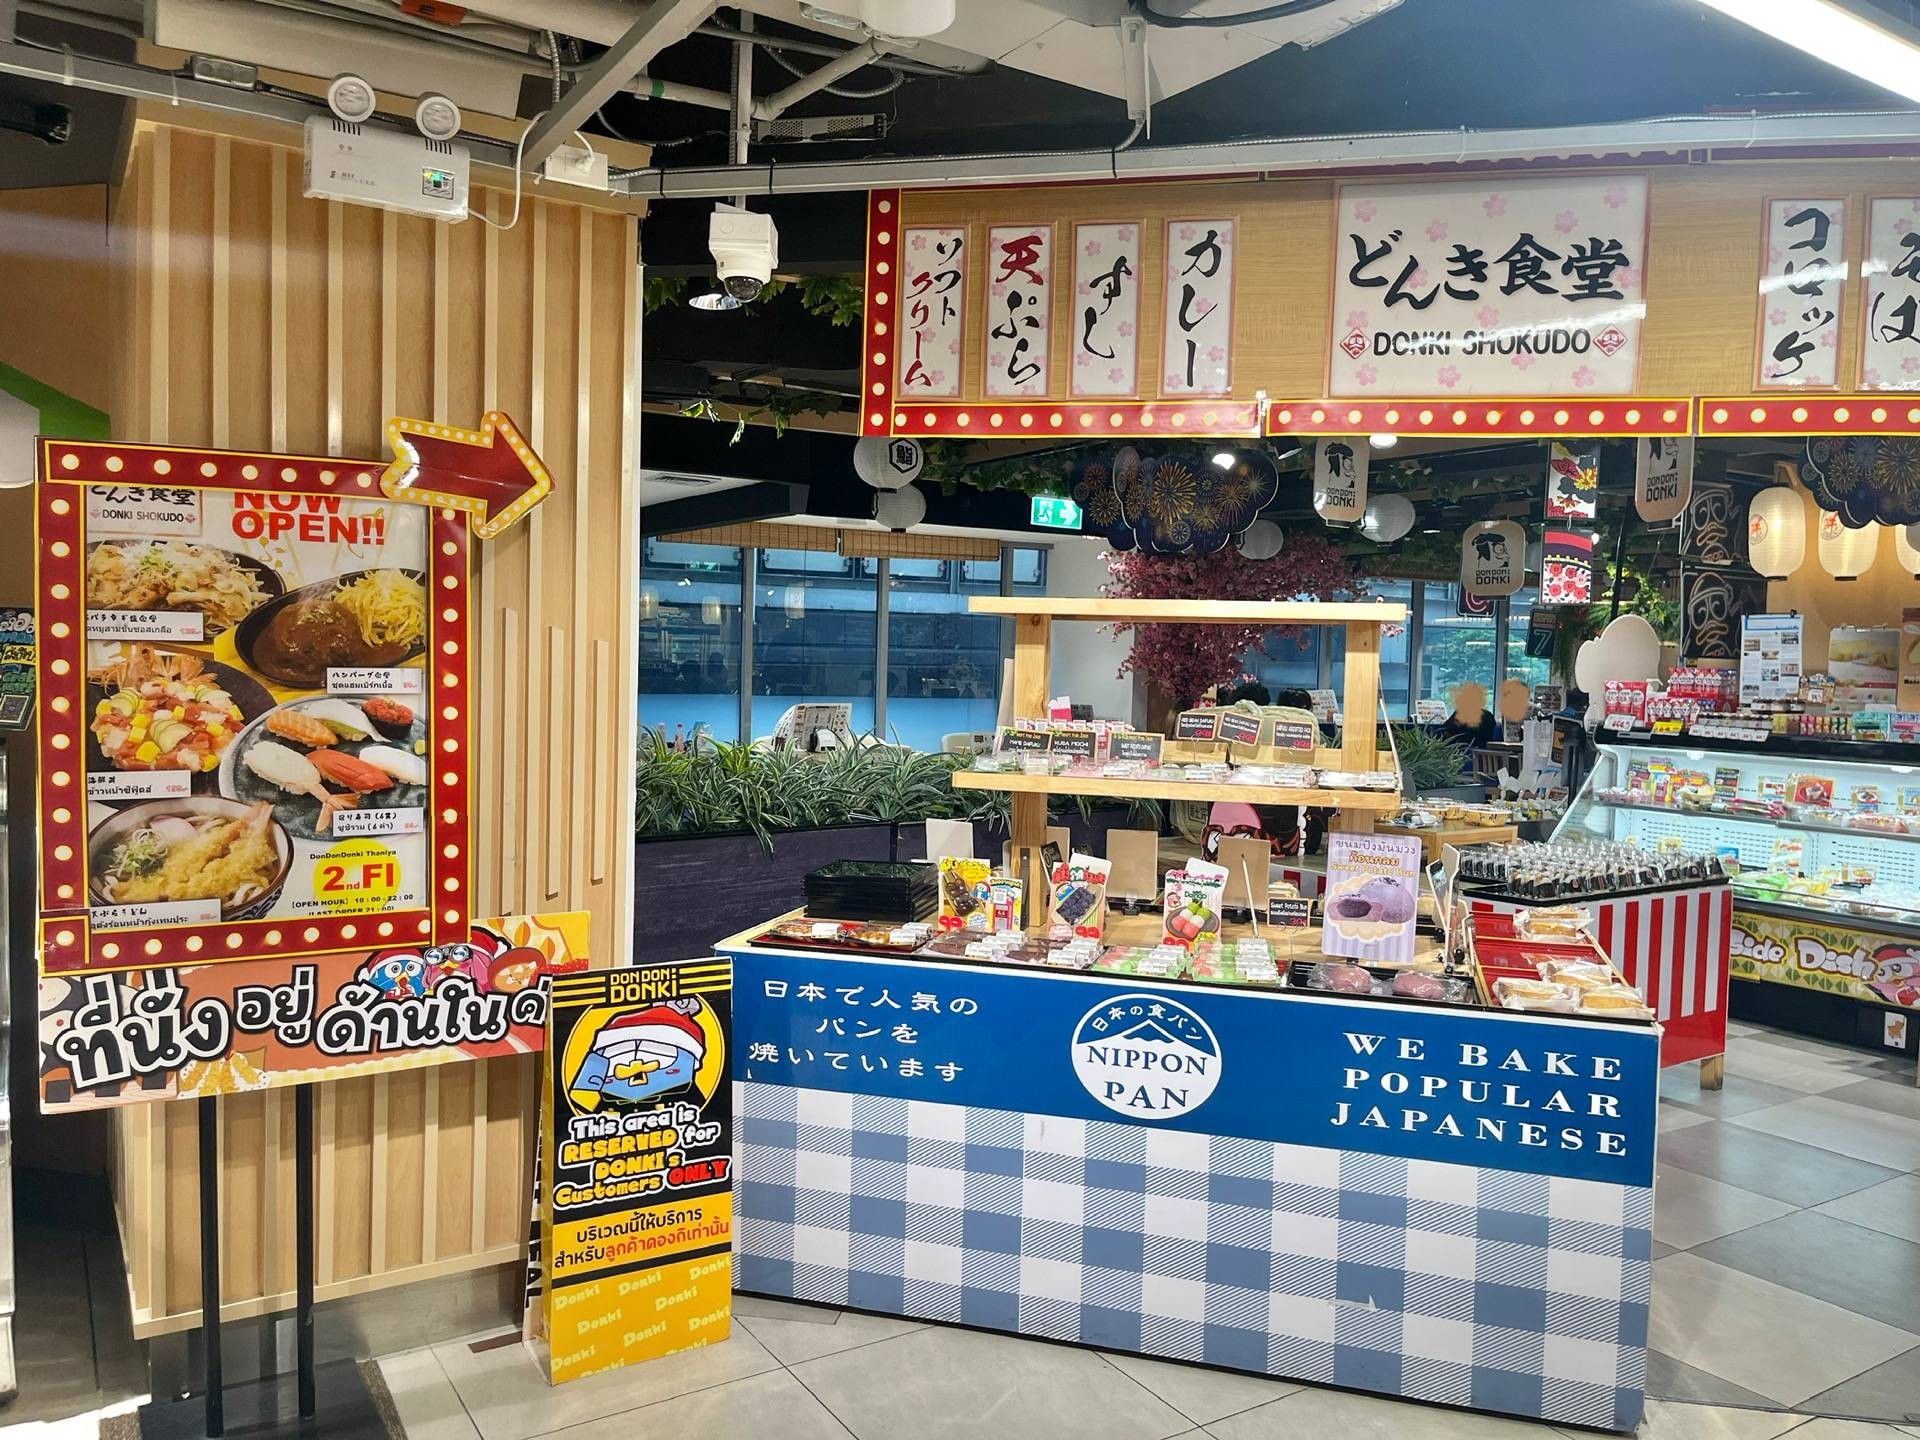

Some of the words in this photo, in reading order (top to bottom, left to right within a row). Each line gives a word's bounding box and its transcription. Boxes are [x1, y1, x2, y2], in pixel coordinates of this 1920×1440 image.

[935, 237, 963, 327] ソフト
[1348, 231, 1631, 310] どんき食堂
[1082, 255, 1132, 359] すし
[1178, 229, 1222, 387] カレー
[1770, 207, 1835, 378] コロッケ
[991, 234, 1044, 386] 天ぷら
[904, 270, 933, 387] クリーム
[1372, 330, 1450, 357] DONKI
[1462, 329, 1591, 356] SHOKUDO
[234, 492, 342, 514] NOW
[1327, 494, 1355, 508] DONKI
[1646, 483, 1677, 503] DONKI
[102, 508, 133, 520] DONKI
[136, 510, 185, 523] SHOKUDO
[231, 511, 385, 546] OPEN!!
[1476, 576, 1510, 585] DONKI
[309, 852, 364, 860] DonDonDonki
[366, 850, 397, 858] Thaniya
[1395, 868, 1416, 878] Bun
[1793, 936, 1879, 981] Dish
[610, 979, 678, 1004] DONKI
[763, 979, 979, 1016] 日本で人気の
[815, 1018, 919, 1045] パンを
[1091, 1003, 1203, 1041] 日本の食パン
[749, 1042, 964, 1083] 焼いています
[1086, 1045, 1208, 1076] NIPPON
[1342, 1031, 1426, 1061] WE
[1459, 1043, 1622, 1082] BAKE
[1103, 1080, 1190, 1110] PAN
[1342, 1067, 1622, 1118] POPULAR
[573, 1119, 618, 1140] This
[624, 1113, 671, 1132] area
[677, 1105, 696, 1124] is
[1330, 1102, 1627, 1157] JAPANESE
[563, 1129, 678, 1164] RESERVED
[684, 1125, 717, 1144] for
[555, 1176, 662, 1206] Customers
[667, 1159, 730, 1186] ONLY
[576, 1208, 703, 1243] บริเวณนี้ให้บริการ
[618, 1270, 663, 1297] Donki
[690, 1256, 731, 1281] Donki
[555, 1284, 600, 1311] Donki
[655, 1285, 698, 1312] Donki
[577, 1308, 622, 1335] Donki
[624, 1320, 668, 1348] Donki
[688, 1305, 731, 1332] Donki
